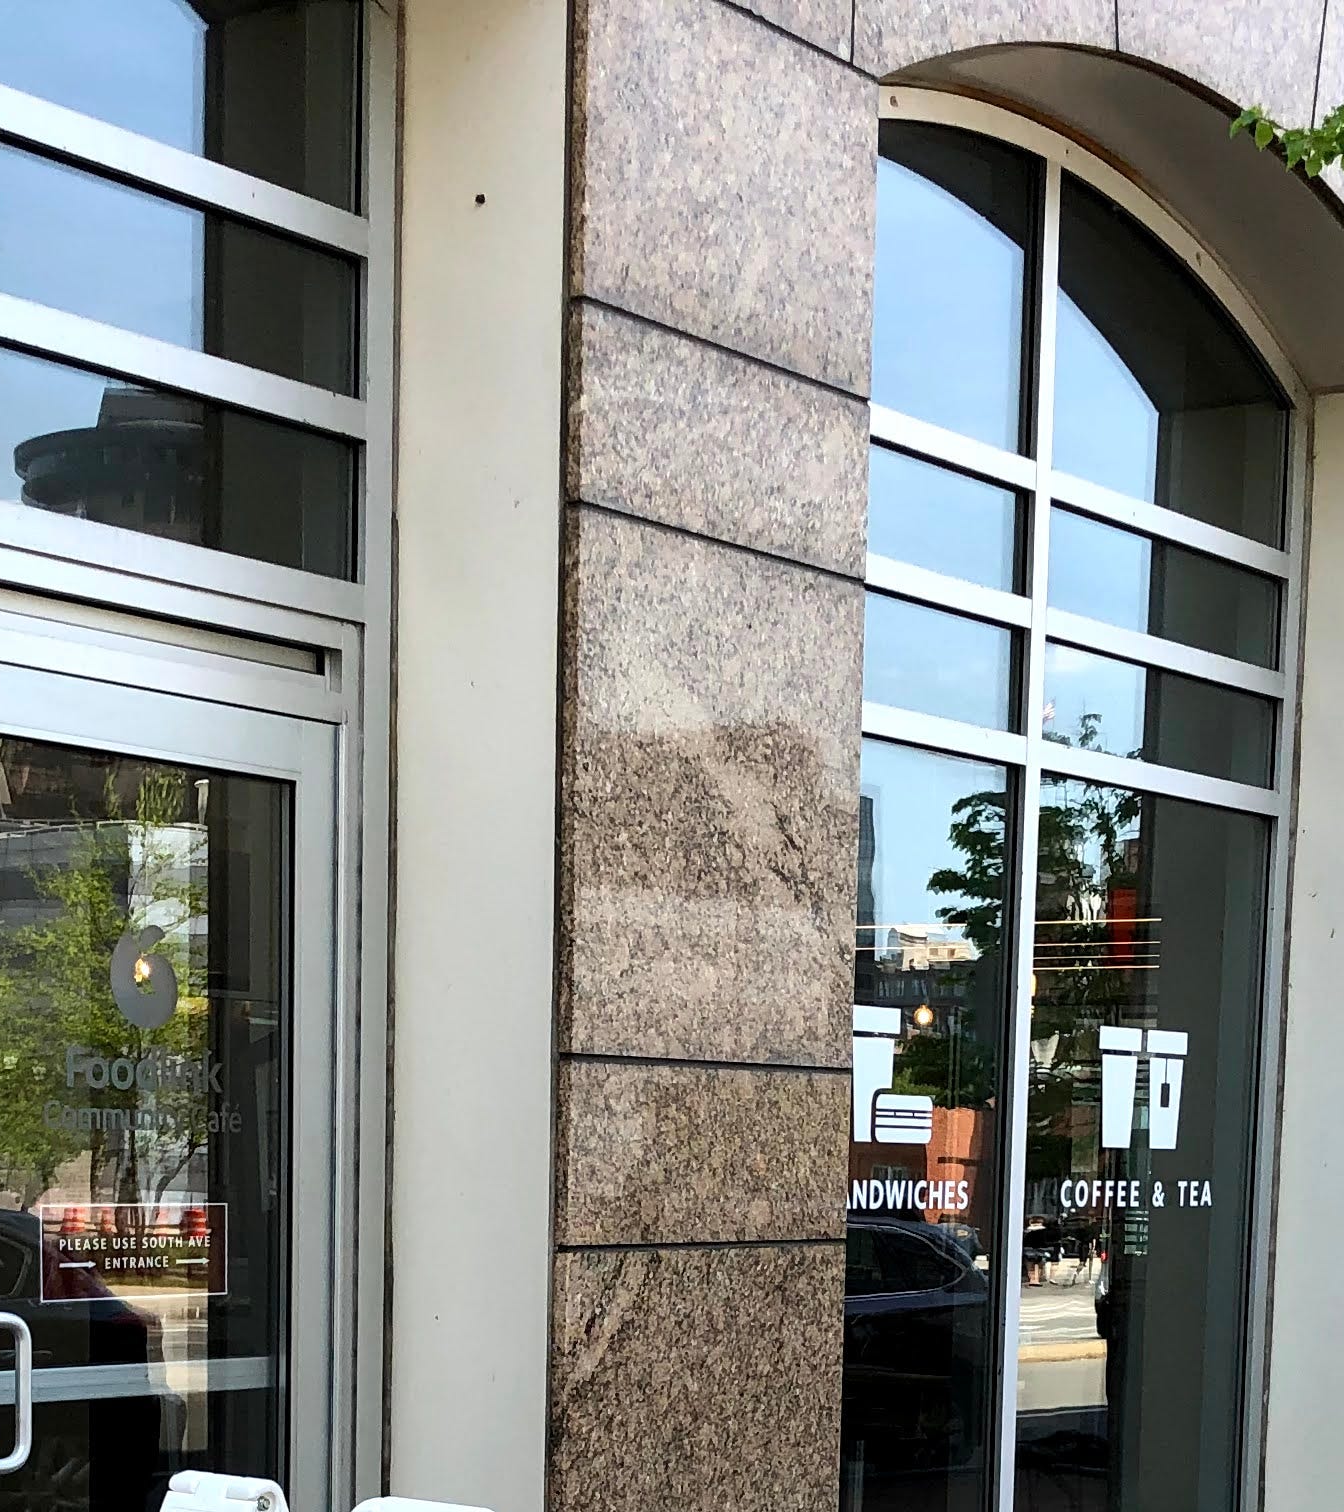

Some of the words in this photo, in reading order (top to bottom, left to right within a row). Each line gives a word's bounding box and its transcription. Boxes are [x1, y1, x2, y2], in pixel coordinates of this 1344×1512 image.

[1060, 1180, 1140, 1208] COFFEE
[1152, 1181, 1165, 1208] &
[1178, 1180, 1213, 1207] TEA
[59, 1238, 107, 1251] PLEASE
[112, 1237, 137, 1250] USE
[142, 1236, 183, 1249] SOUTH
[188, 1235, 211, 1247] AVE
[104, 1255, 169, 1270] ENTRANCE
